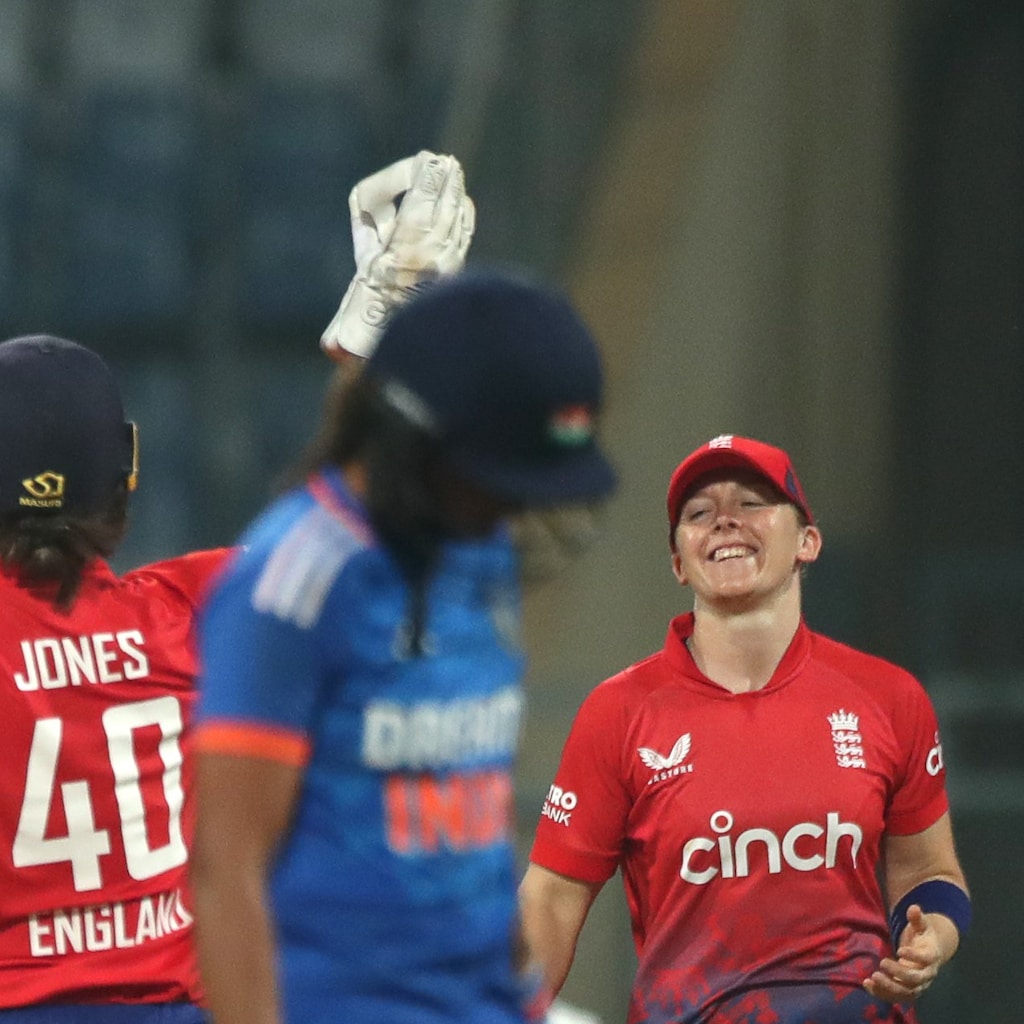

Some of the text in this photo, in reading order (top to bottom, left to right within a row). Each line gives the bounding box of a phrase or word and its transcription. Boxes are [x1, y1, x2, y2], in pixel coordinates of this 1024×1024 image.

[14, 629, 149, 692] JONES
[12, 695, 188, 892] 40
[680, 810, 863, 885] cinch
